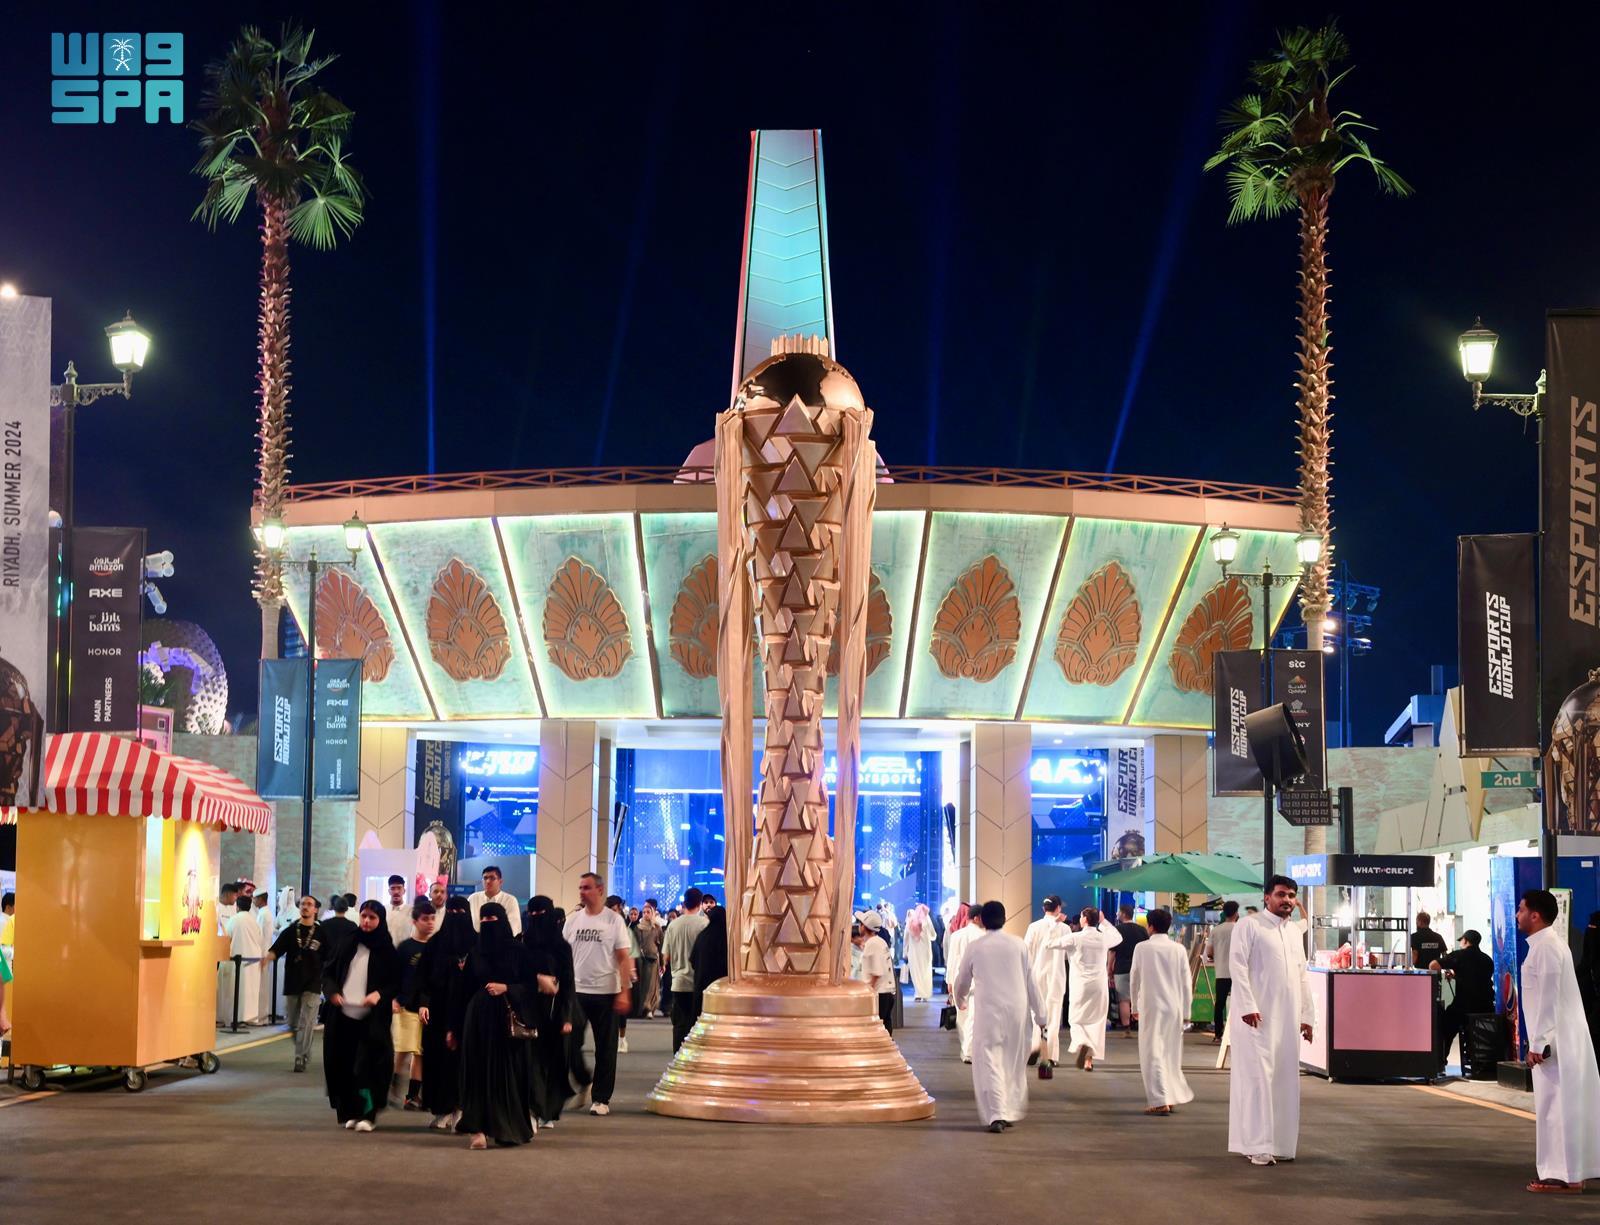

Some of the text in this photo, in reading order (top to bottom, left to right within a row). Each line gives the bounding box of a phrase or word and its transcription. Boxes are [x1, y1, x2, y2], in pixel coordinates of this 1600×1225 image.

[3, 420, 22, 587] RIYADH, SUMMER 2024
[1569, 396, 1597, 626] ESPORTS
[89, 563, 124, 571] amazon
[89, 588, 122, 598] AXE
[88, 648, 122, 656] HONOR
[1289, 660, 1306, 668] stc
[1486, 591, 1502, 696] ESPORTS
[1499, 596, 1514, 699] WORLD CUP
[104, 677, 113, 722] PARTNERS
[1230, 687, 1240, 757] ESPORTS
[1239, 690, 1247, 716] CUP
[274, 694, 284, 763] ESPORTS
[283, 723, 291, 765] WORLD
[433, 756, 442, 809] WORLD
[1128, 764, 1137, 817] WORLD
[1494, 772, 1521, 786] 2nd
[576, 929, 603, 943] MORE
